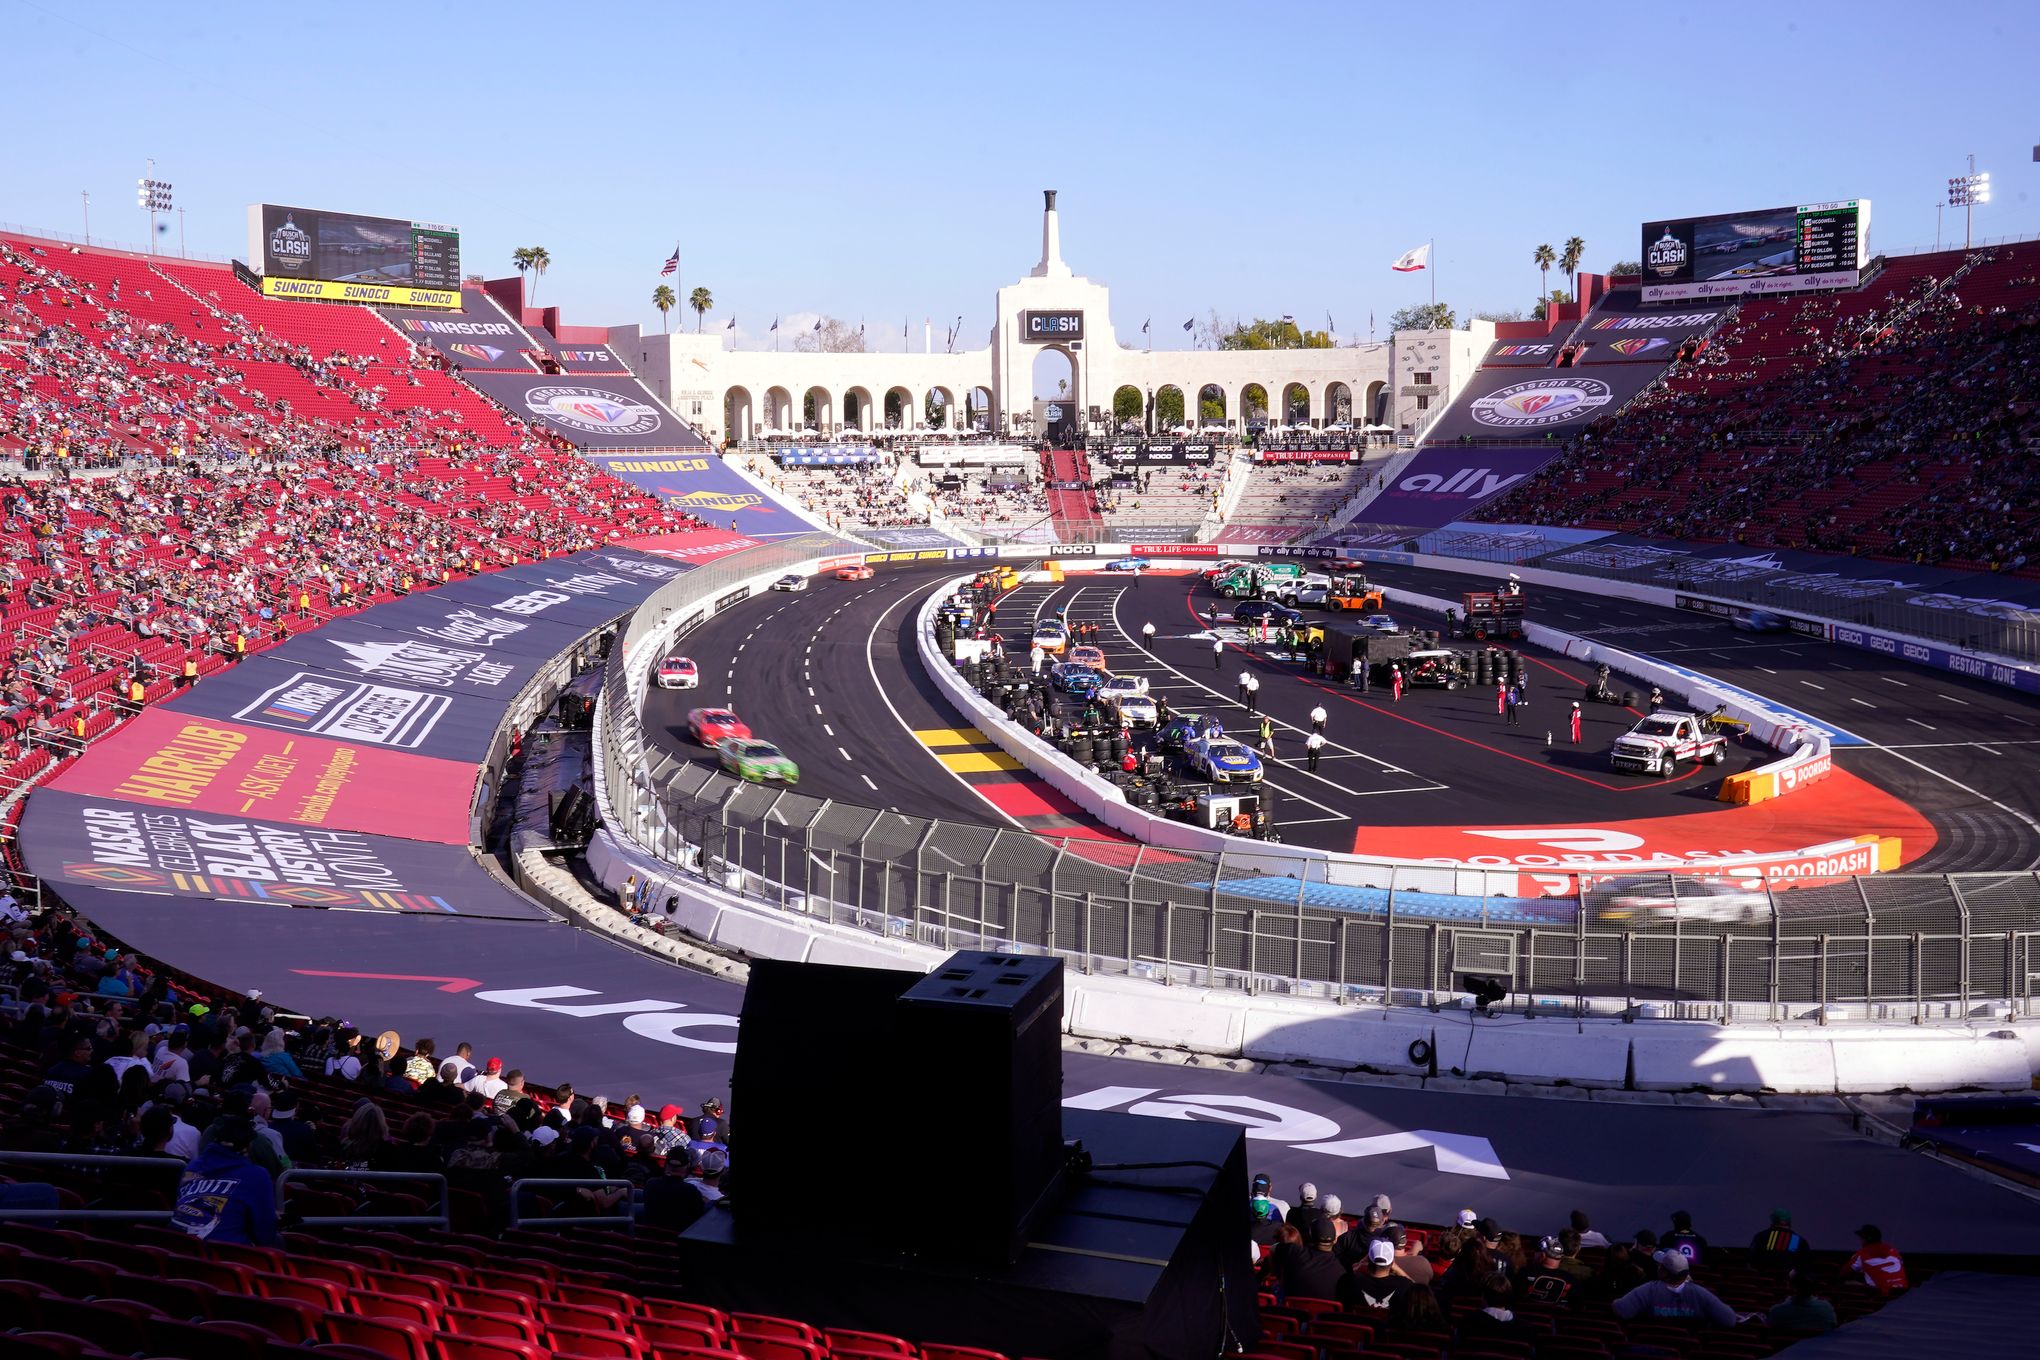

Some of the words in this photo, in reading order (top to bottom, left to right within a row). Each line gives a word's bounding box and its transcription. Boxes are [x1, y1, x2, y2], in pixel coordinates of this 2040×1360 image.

[273, 239, 309, 255] CLASH
[1650, 249, 1684, 264] CLASH
[1698, 284, 1714, 294] ally
[1750, 280, 1765, 290] ally
[1804, 276, 1821, 287] ally
[274, 281, 323, 295] SUNOCO
[344, 286, 390, 299] SUNOCO
[410, 291, 453, 304] SUNOCO
[1649, 288, 1663, 298] ally
[433, 321, 514, 335] NASCAR
[1032, 316, 1079, 332] CLASH
[1622, 313, 1718, 329] NASCAR
[583, 351, 609, 362] 75
[1520, 344, 1553, 355] 75
[532, 388, 578, 402] NASCAR
[580, 390, 624, 403] 75TH
[1503, 381, 1568, 396] NASCAR
[1570, 380, 1602, 394] 75TH
[1479, 406, 1584, 425] ANNIVERSARY
[556, 416, 653, 434] ANNIVERSARY
[608, 458, 710, 472] SUNOCO
[1400, 469, 1527, 499] ally
[673, 494, 758, 506] SUNOCO
[866, 554, 888, 562] SUNOCO
[890, 553, 915, 561] SUNOCO
[918, 551, 946, 559] SUNOCO
[1052, 546, 1093, 555] NOCO
[1277, 548, 1289, 557] ally
[1293, 548, 1305, 557] ally
[1308, 548, 1319, 557] ally
[1322, 550, 1333, 558] ally
[1838, 628, 1862, 645] GEICO
[1870, 636, 1895, 653] GEICO
[1904, 644, 1930, 661] GEICO
[370, 641, 486, 686] BUSCH
[1950, 655, 1986, 677] RESTART
[1992, 666, 2016, 685] ZONE
[275, 682, 346, 712] NASCAR
[113, 725, 248, 804] HAIRCLUB
[252, 754, 299, 778] JOEY!
[1647, 761, 1655, 770] 2
[236, 773, 284, 800] ASK
[83, 808, 151, 868] NASCAR
[141, 812, 201, 872] CELEBRATES
[186, 817, 278, 881] BLACK
[253, 824, 336, 886] HISTORY
[304, 830, 408, 892] MONTH
[1768, 851, 1868, 886] DOORDASH
